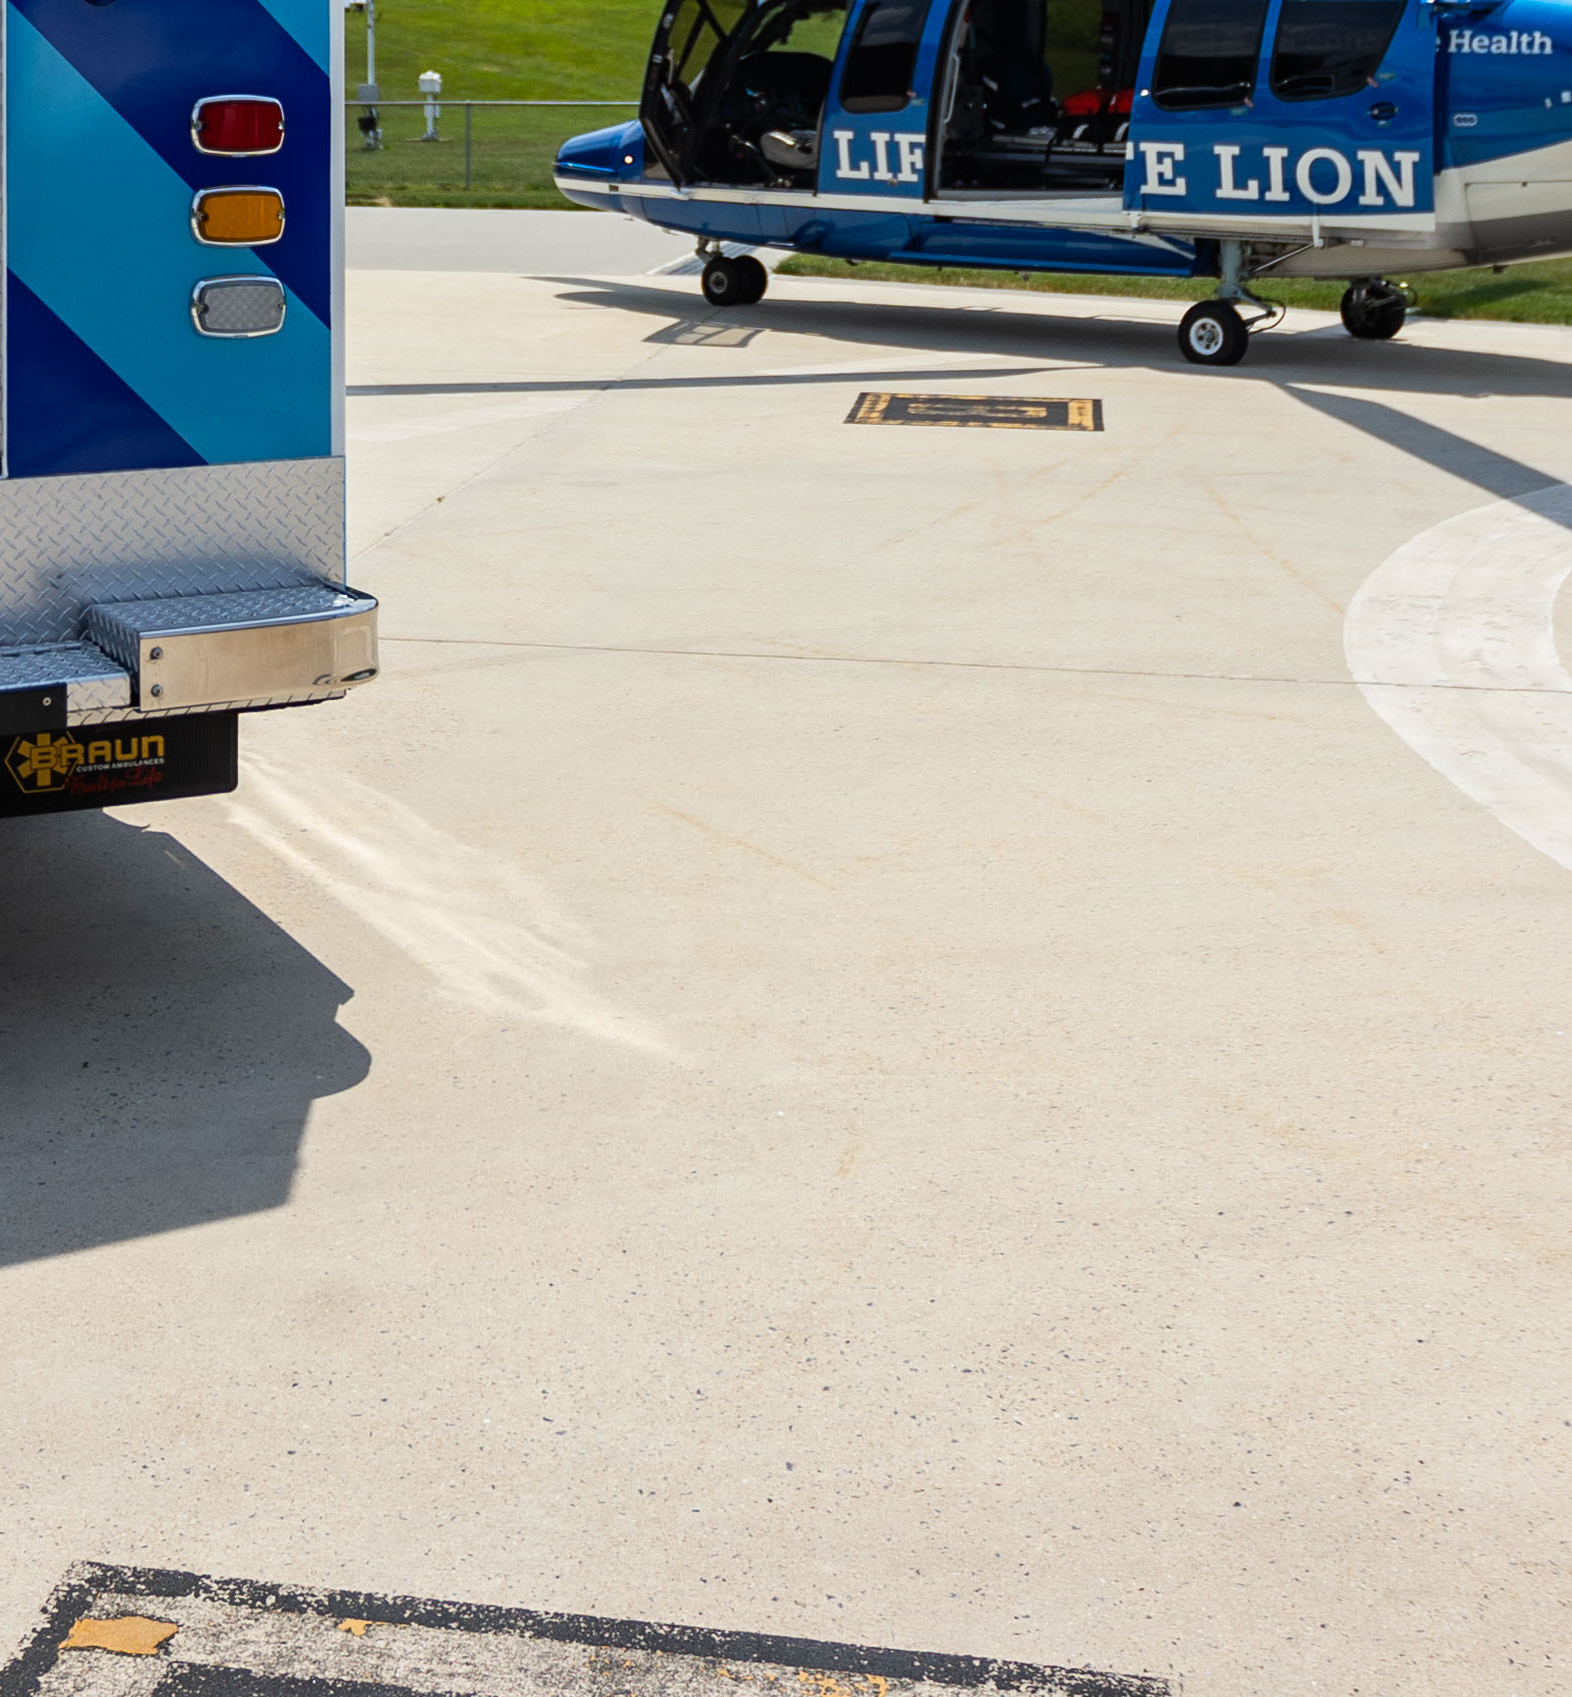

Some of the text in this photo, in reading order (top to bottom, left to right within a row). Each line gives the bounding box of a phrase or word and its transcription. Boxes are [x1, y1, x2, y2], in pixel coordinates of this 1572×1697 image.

[1448, 29, 1553, 54] Health
[1126, 142, 1420, 207] E LION
[30, 734, 165, 770] BRAUN
[75, 763, 111, 773] CUSTOM
